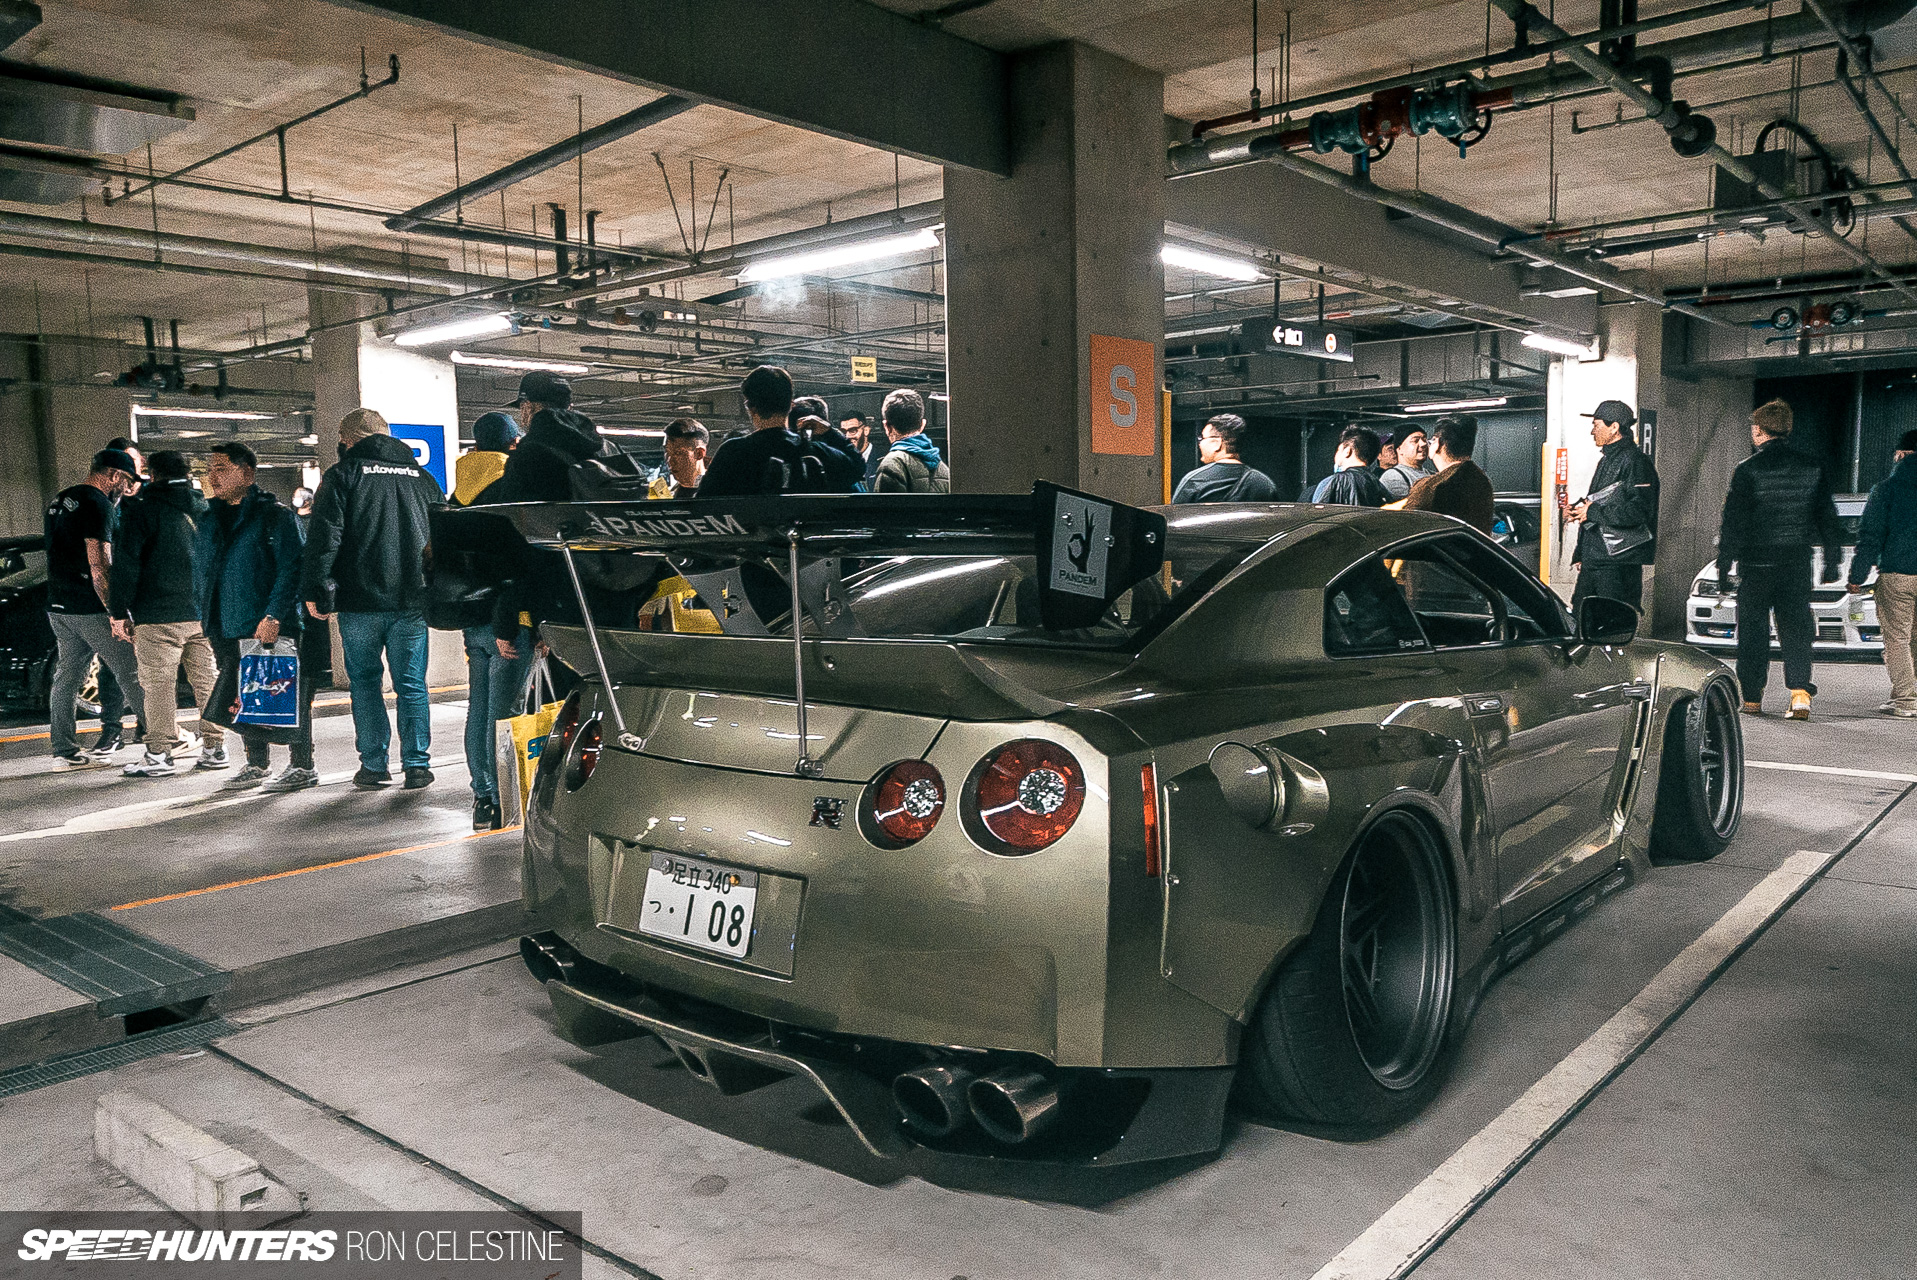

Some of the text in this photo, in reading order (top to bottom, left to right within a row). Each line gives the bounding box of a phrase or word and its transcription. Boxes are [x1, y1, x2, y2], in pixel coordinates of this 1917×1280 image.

[1110, 364, 1137, 428] S
[362, 464, 420, 478] autowerks
[602, 514, 749, 537] PANDEM
[1059, 569, 1097, 587] PANDEM
[672, 862, 732, 895] 足立 340
